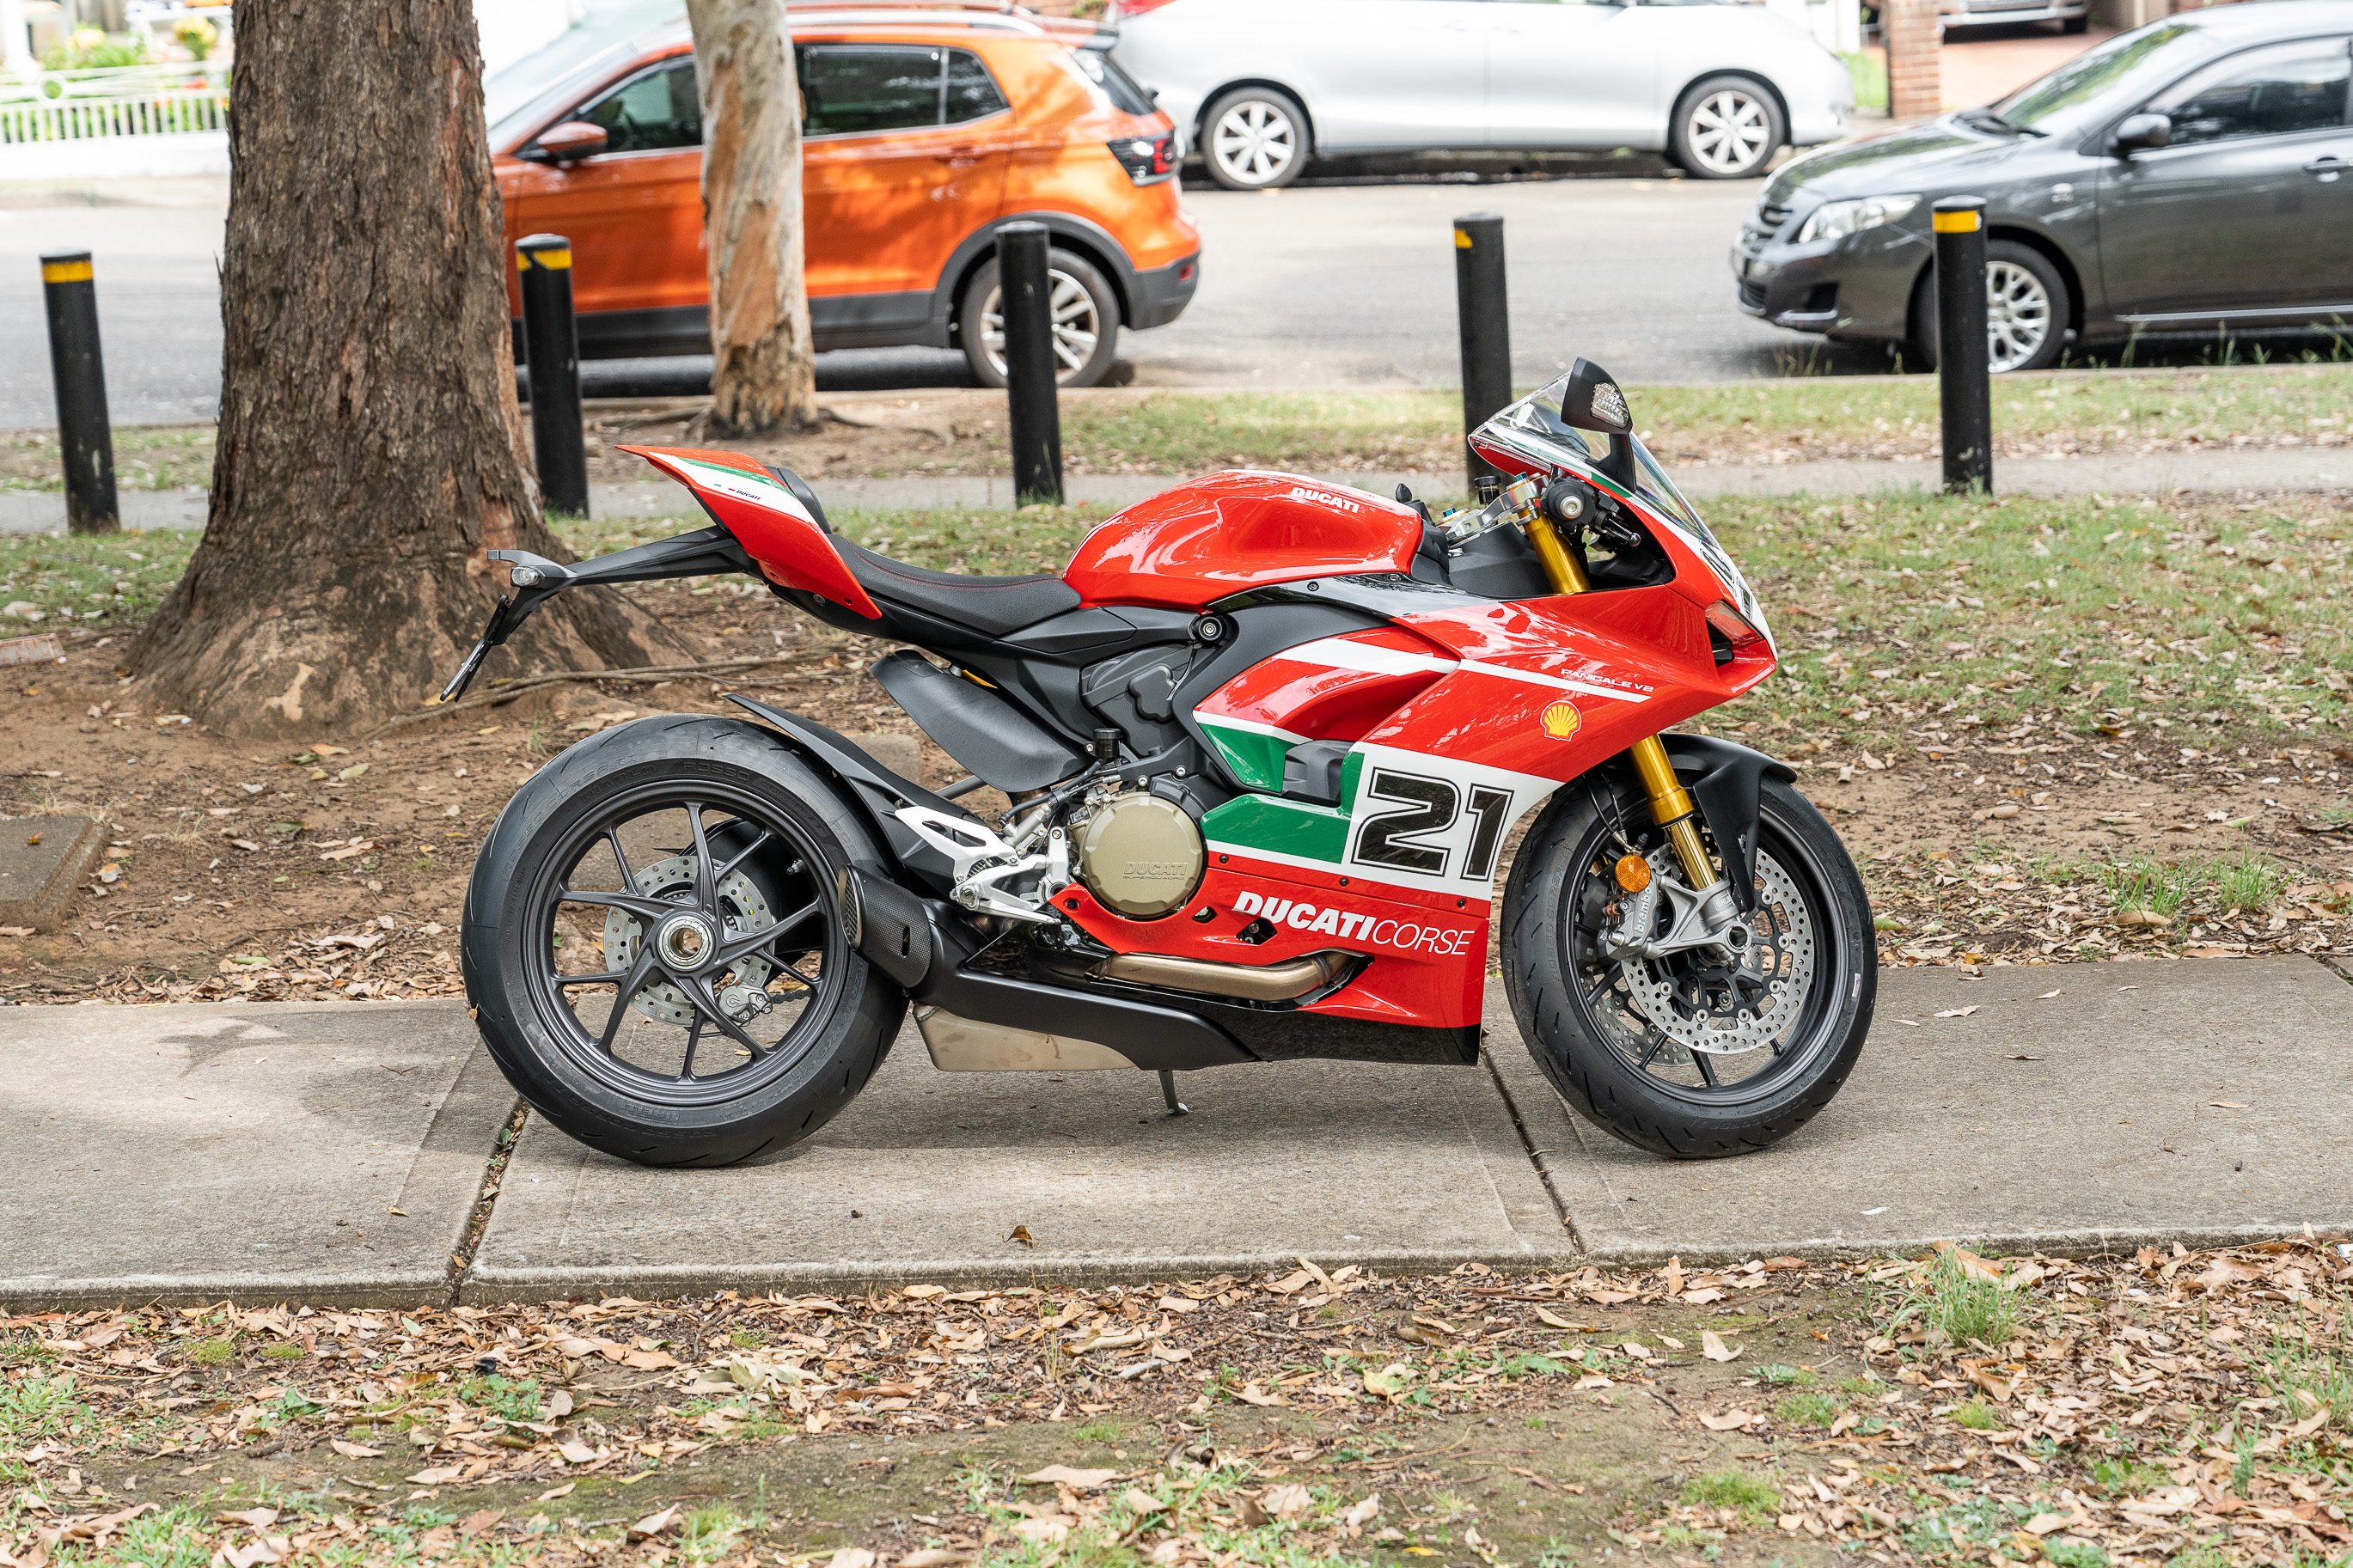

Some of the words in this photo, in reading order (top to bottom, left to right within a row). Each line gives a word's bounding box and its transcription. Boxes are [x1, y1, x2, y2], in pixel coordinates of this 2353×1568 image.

[736, 490, 761, 500] DUCATI
[1290, 486, 1360, 514] DUCATI
[1561, 668, 1632, 688] PANIGALE
[1634, 683, 1654, 692] V2
[683, 761, 750, 783] ROSSO
[760, 781, 804, 814] CORSA
[1761, 792, 1804, 829] ROSSO
[1351, 766, 1514, 882] 21
[1123, 861, 1188, 876] DUCATI
[1548, 863, 1565, 918] CORSA
[1232, 890, 1377, 942] DUCATI
[1372, 919, 1475, 955] CORSE
[1634, 887, 1652, 934] brembo
[1547, 923, 1561, 981] ROSSO
